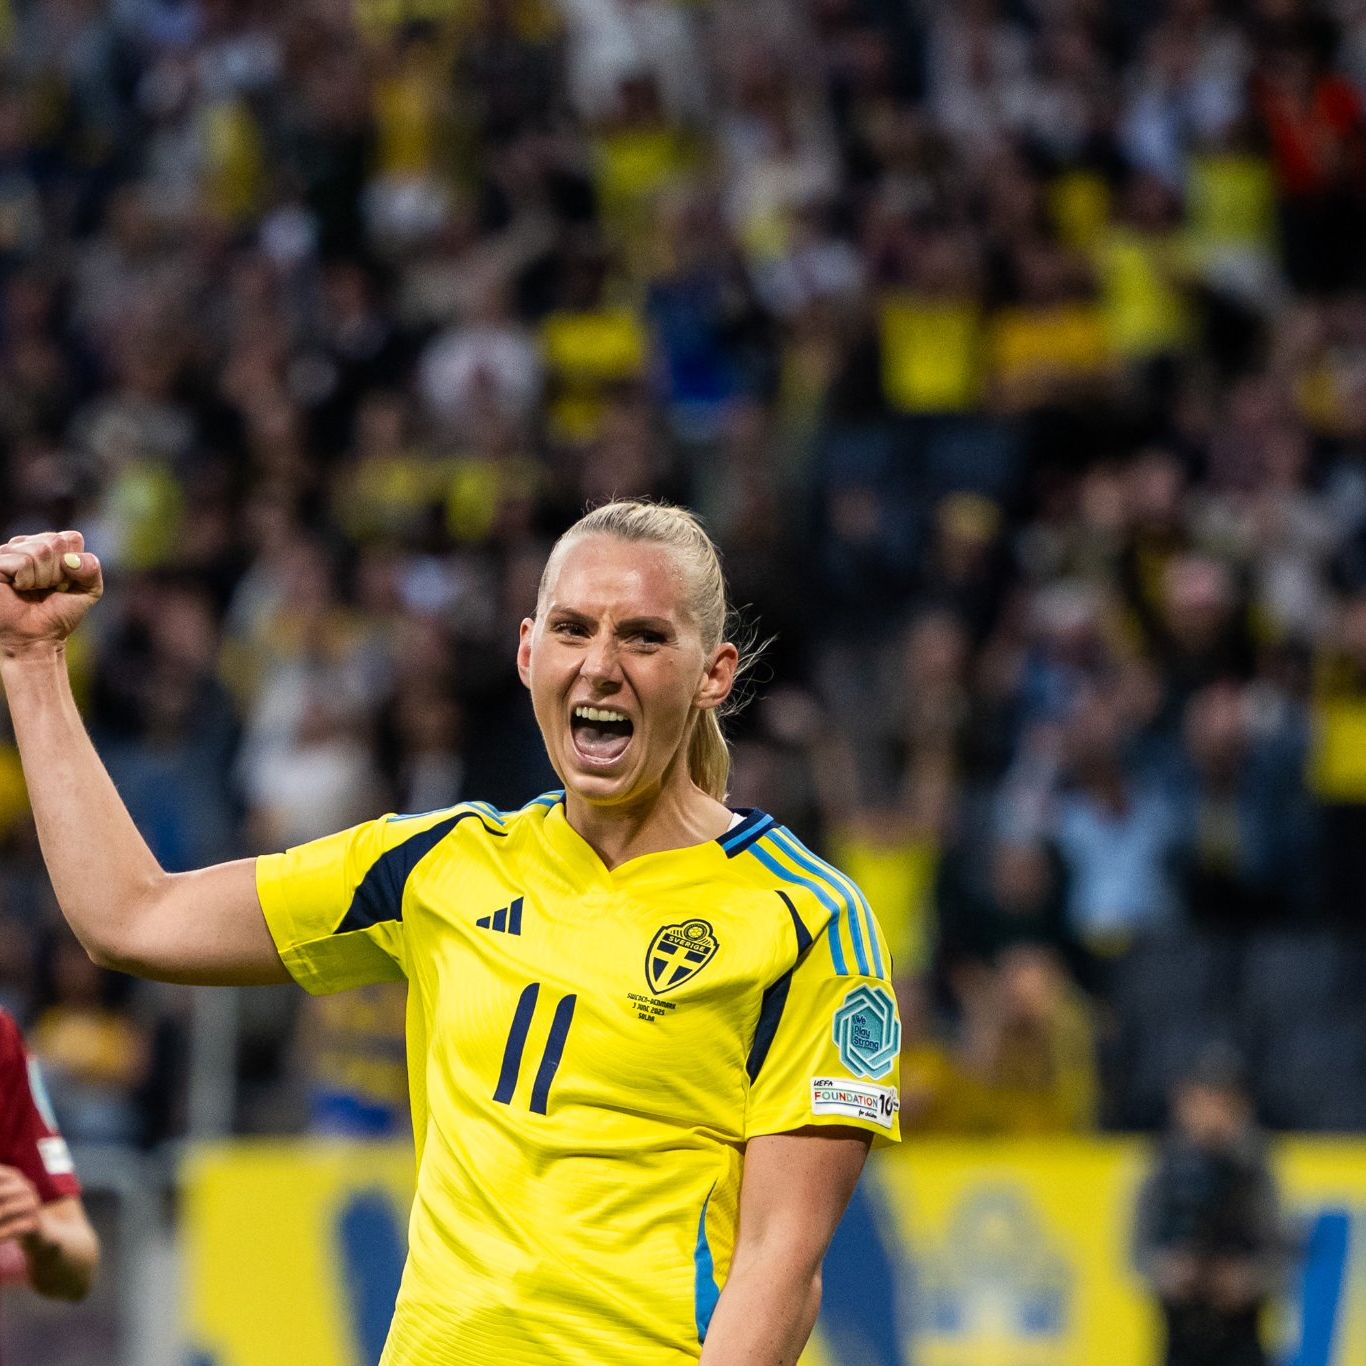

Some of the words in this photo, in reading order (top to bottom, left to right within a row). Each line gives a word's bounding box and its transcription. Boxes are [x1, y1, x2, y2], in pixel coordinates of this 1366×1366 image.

[667, 935, 706, 952] SVERIGE
[855, 1015, 866, 1025] We
[854, 1025, 871, 1039] Play
[492, 982, 577, 1115] 11
[853, 1036, 879, 1052] Strong
[813, 1079, 834, 1087] UEFA
[814, 1091, 878, 1108] FOUNDATION
